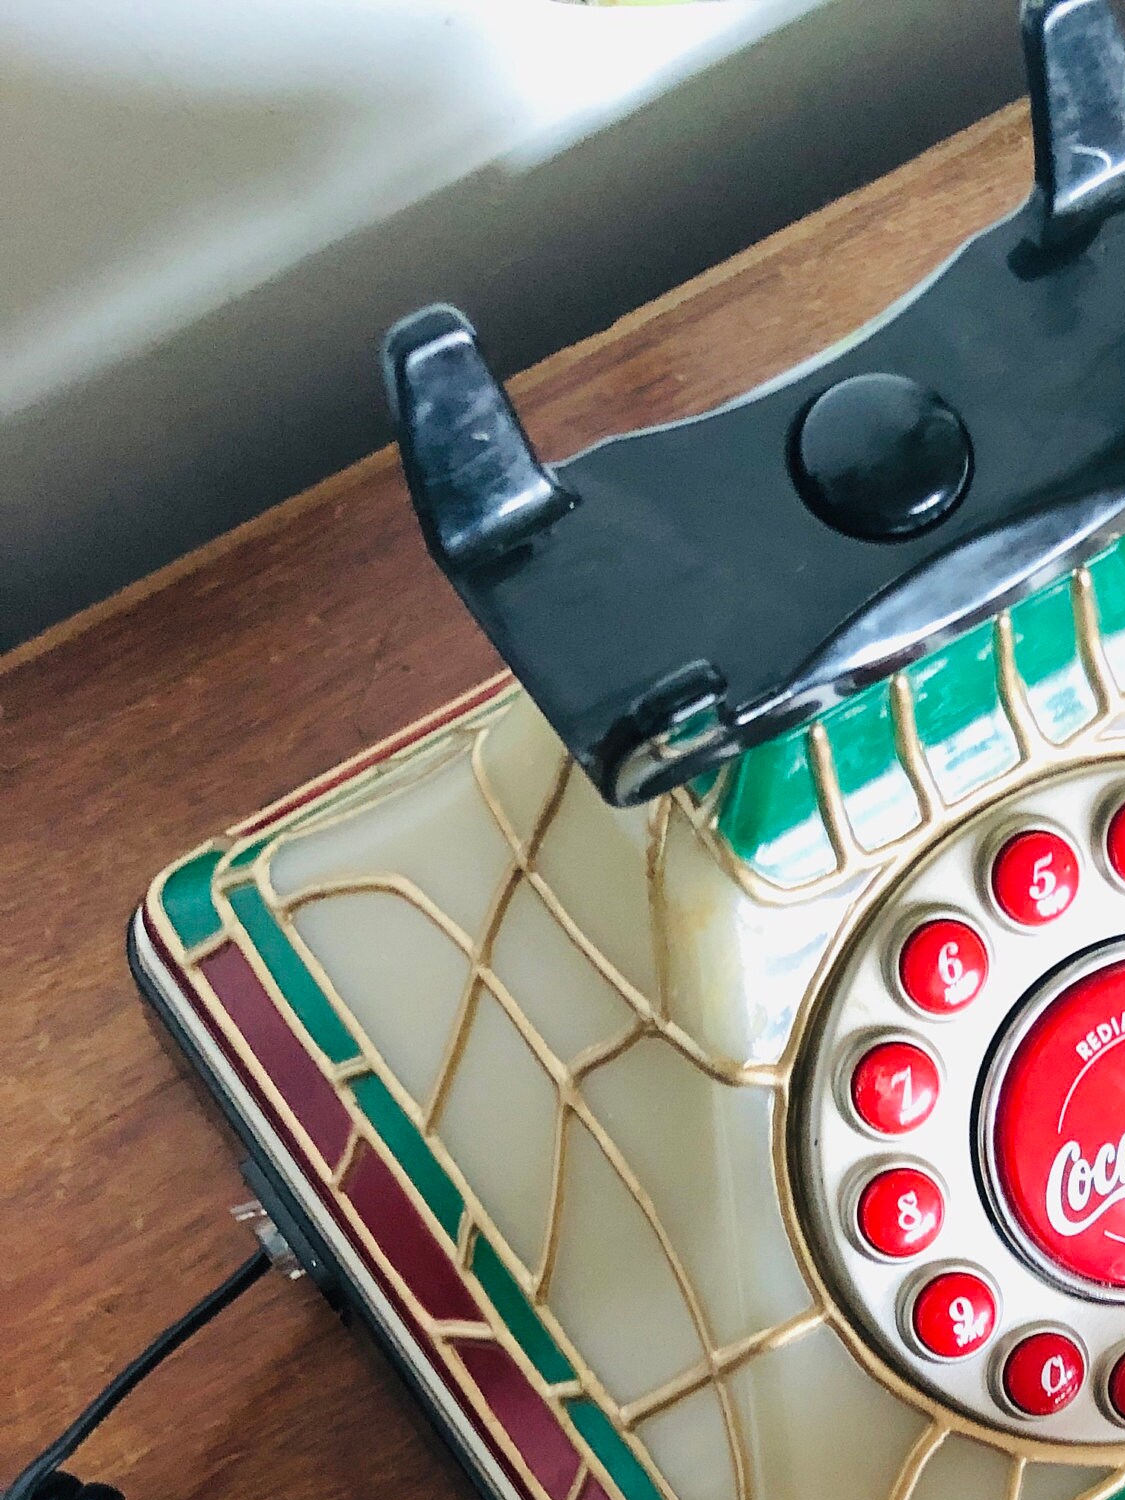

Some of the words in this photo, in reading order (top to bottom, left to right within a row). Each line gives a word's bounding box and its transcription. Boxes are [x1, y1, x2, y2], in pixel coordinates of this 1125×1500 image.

[1029, 851, 1057, 900] 5
[938, 941, 963, 985] 6
[891, 1066, 913, 1114] 7
[897, 1190, 922, 1231] 8
[949, 1296, 974, 1335] 9
[1041, 1354, 1067, 1397] 0
